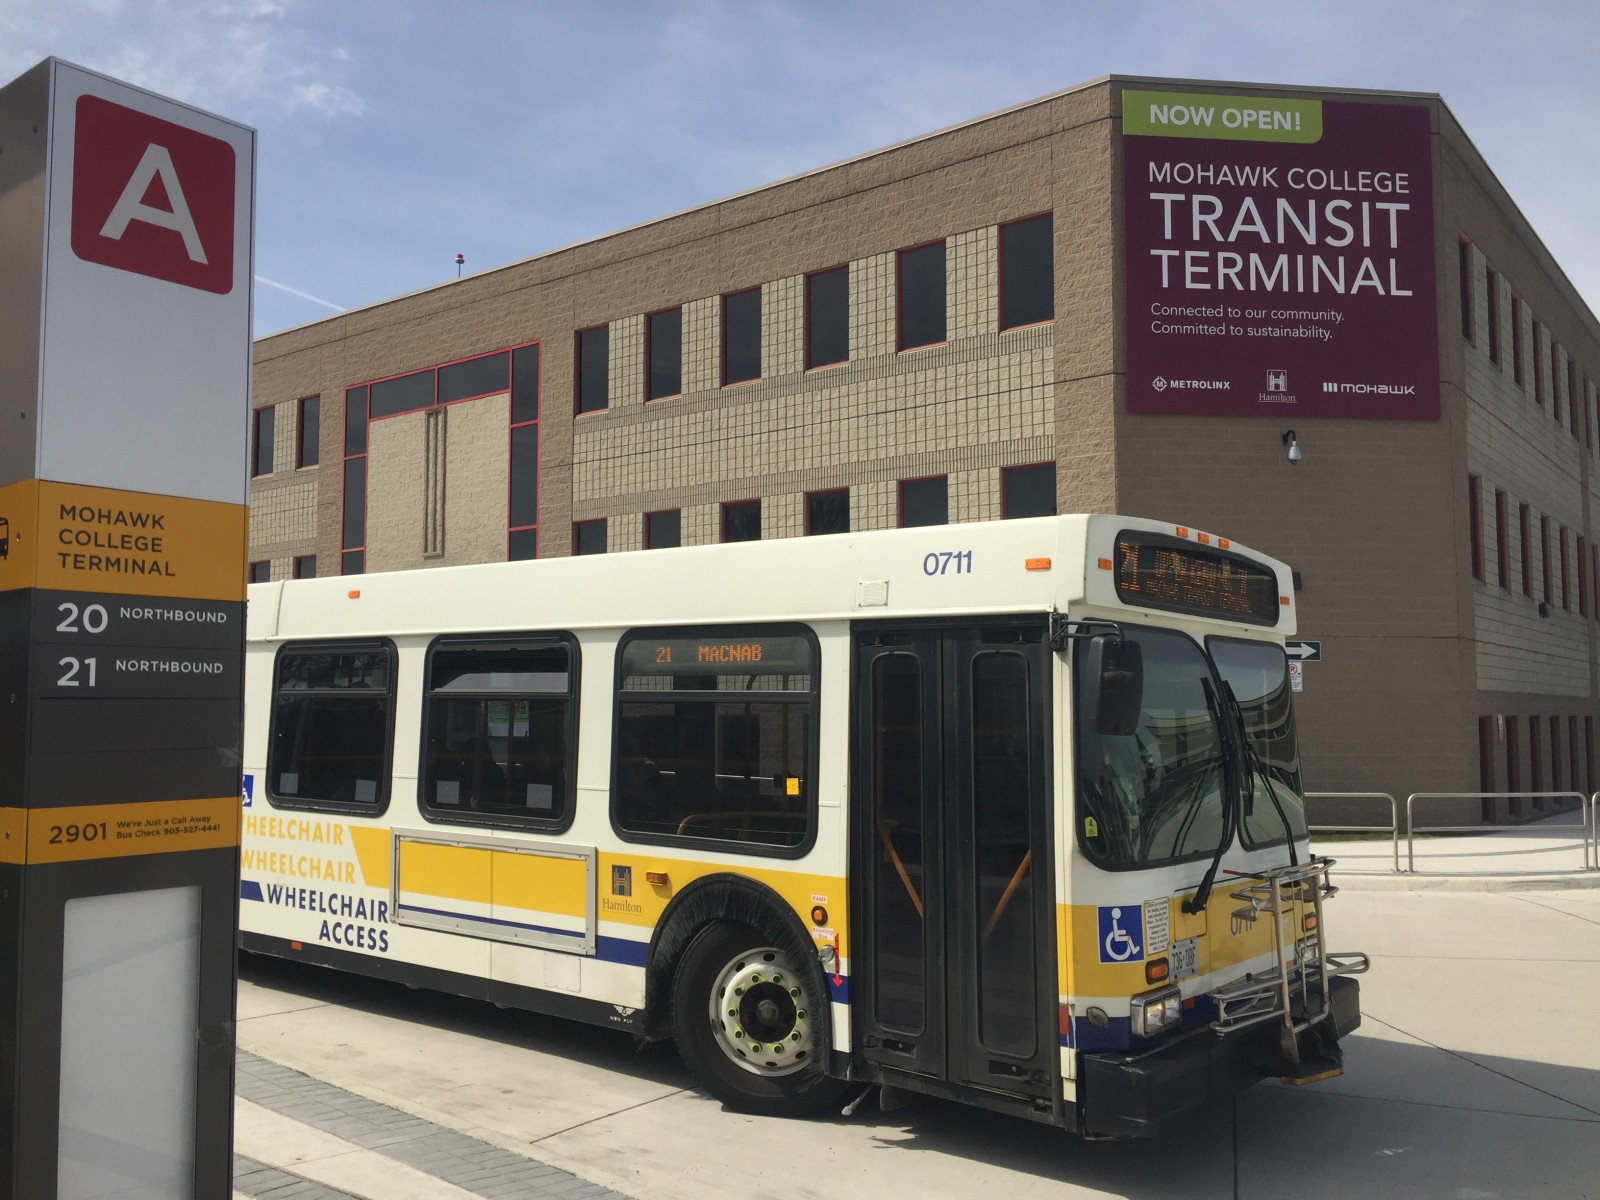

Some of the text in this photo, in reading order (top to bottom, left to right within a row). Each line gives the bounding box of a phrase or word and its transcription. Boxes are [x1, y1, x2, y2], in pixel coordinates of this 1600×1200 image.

[1150, 104, 1300, 131] NOW OPEN!
[1149, 161, 1410, 193] MOHAWK COLLEGE
[99, 142, 209, 265] A
[1150, 192, 1410, 249] TRANSIT
[1150, 249, 1413, 296] TERMINAL
[1150, 302, 1345, 324] Connected to our community.
[1150, 320, 1333, 342] Committed to sustainability.
[1170, 379, 1231, 390] METROLINX
[1258, 392, 1296, 402] Hamilton
[60, 504, 165, 530] MOHAWK
[58, 528, 163, 553] COLLEGE
[57, 552, 176, 577] TERMINAL
[923, 550, 972, 576] 0711
[56, 602, 227, 634] 20 NORTHBOUND
[656, 644, 762, 663] 21 MACNAB
[57, 656, 223, 687] 21 NORTHBOUND
[49, 822, 107, 844] 2901
[117, 820, 142, 829] We're
[144, 818, 162, 827] Just
[171, 816, 187, 825] Call
[190, 815, 211, 824] Away
[116, 830, 132, 840] Bus
[135, 828, 161, 838] Check
[242, 815, 344, 845] HEELCHAIR
[241, 850, 355, 884] WHEELCHAIR
[267, 883, 388, 924] WHEELCHAIR
[602, 898, 642, 913] Hamilton
[319, 919, 389, 953] ACCESS
